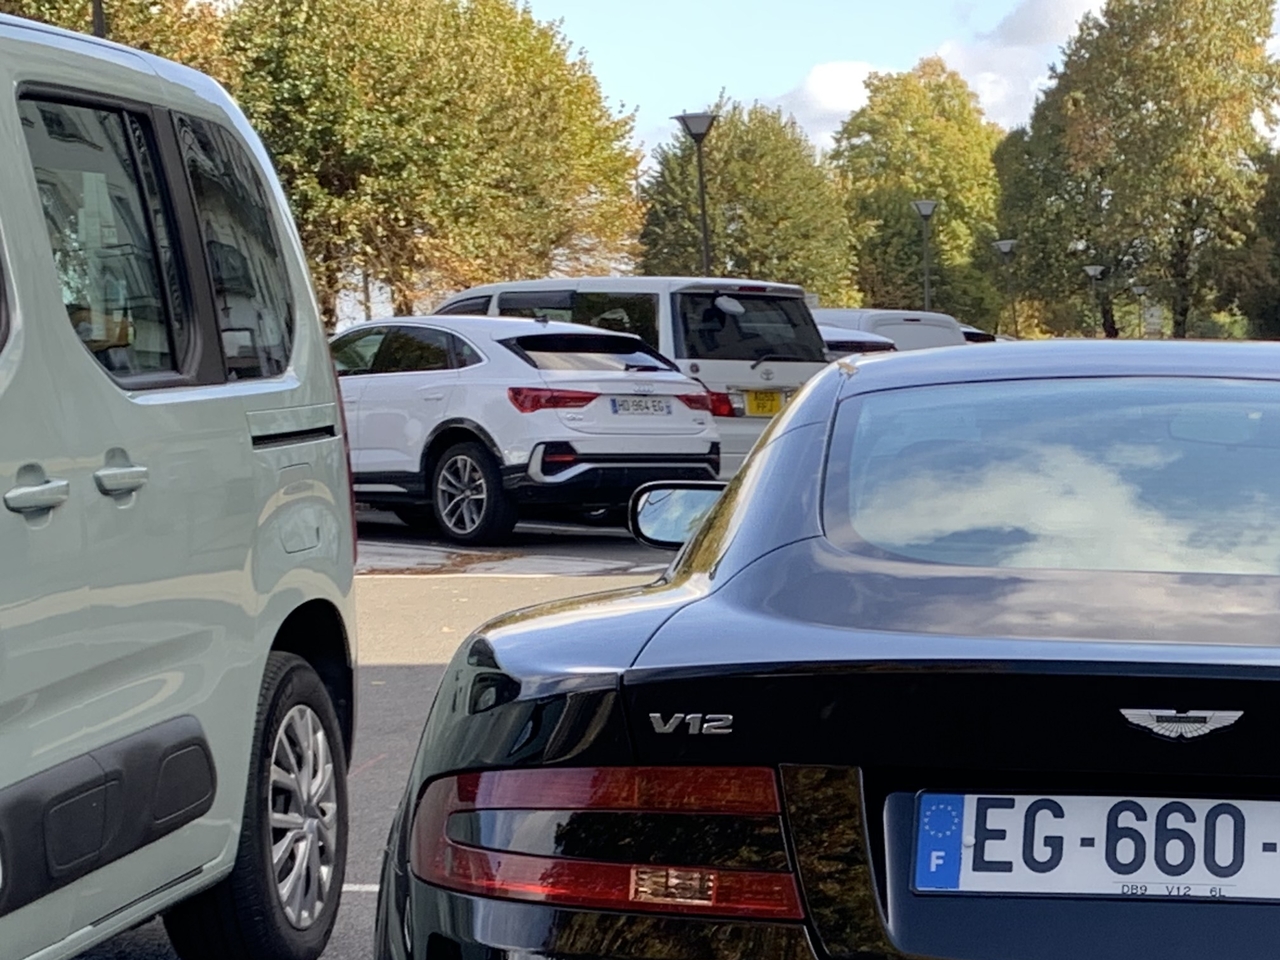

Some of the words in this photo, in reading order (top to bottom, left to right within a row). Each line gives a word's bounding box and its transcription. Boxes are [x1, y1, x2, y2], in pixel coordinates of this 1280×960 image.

[648, 713, 734, 735] V12
[930, 852, 945, 872] F
[1121, 884, 1149, 896] DB9
[1165, 885, 1192, 897] V12
[1209, 886, 1226, 898] 6L
